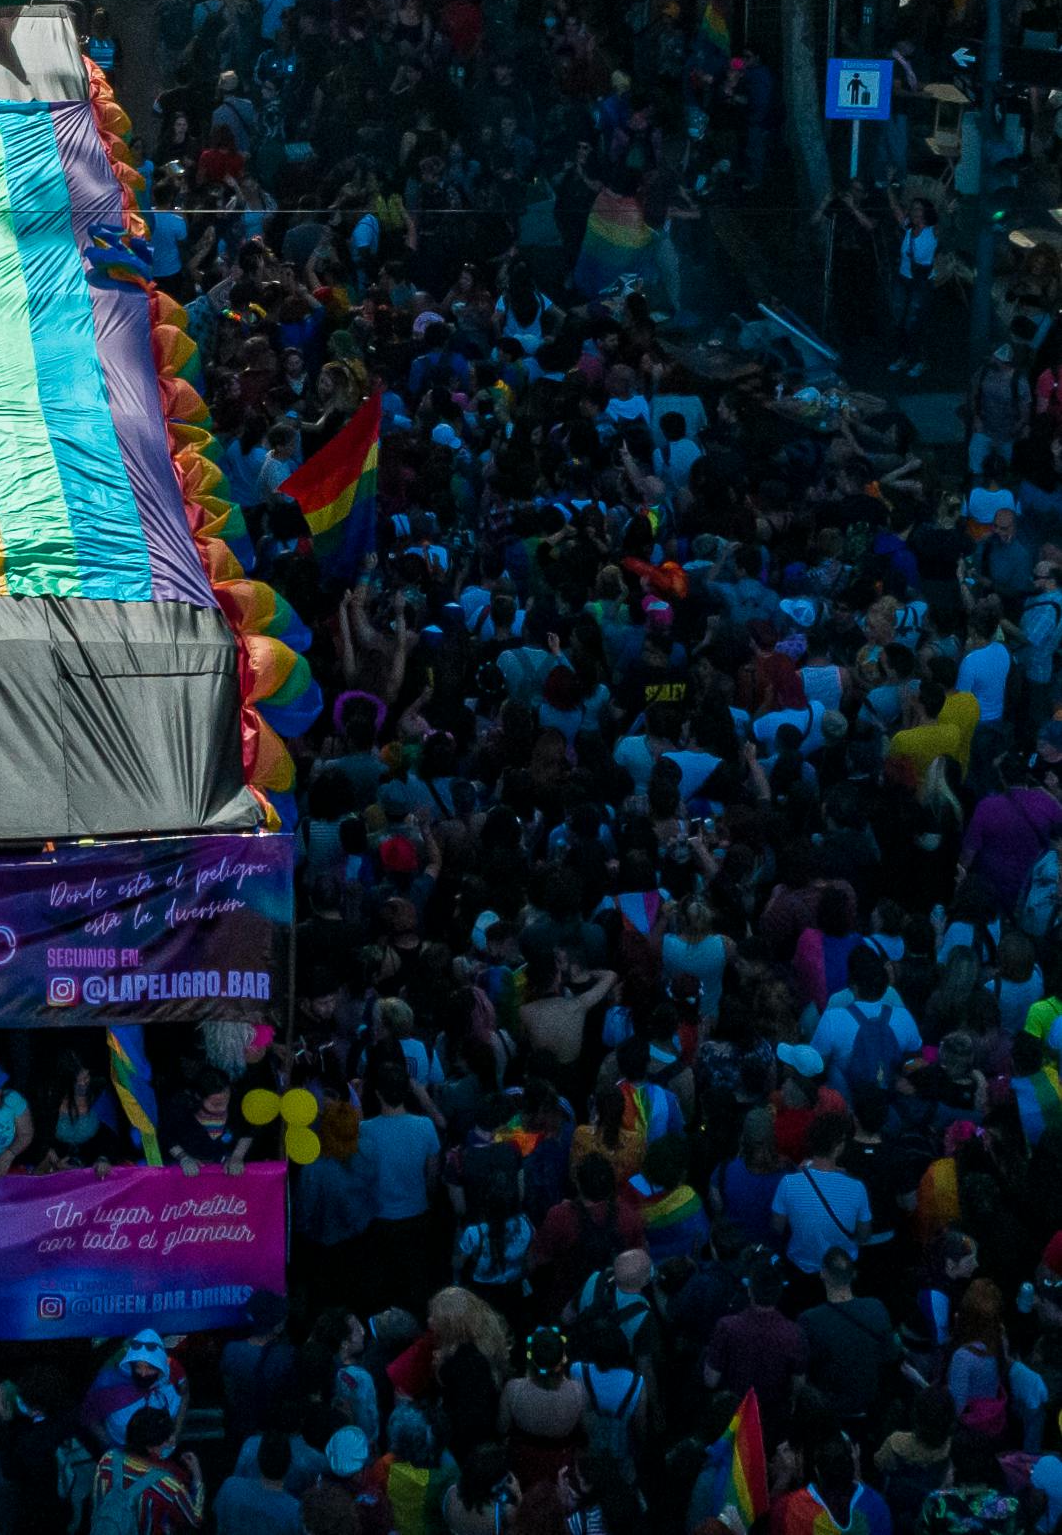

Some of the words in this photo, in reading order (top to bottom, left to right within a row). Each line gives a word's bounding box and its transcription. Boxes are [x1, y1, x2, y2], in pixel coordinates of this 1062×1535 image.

[50, 877, 108, 907] Donde
[166, 865, 184, 889] el
[134, 904, 154, 930] la
[165, 898, 246, 929] diversión
[47, 947, 116, 968] SEGUINOS
[82, 970, 271, 1004] @LAPELIGRO.BAR
[46, 1201, 87, 1230] Un
[93, 1205, 154, 1231] lugar
[160, 1194, 248, 1222] increíble
[38, 1236, 75, 1253] con
[82, 1229, 132, 1250] todo
[138, 1229, 159, 1250] el
[161, 1223, 256, 1255] glamour
